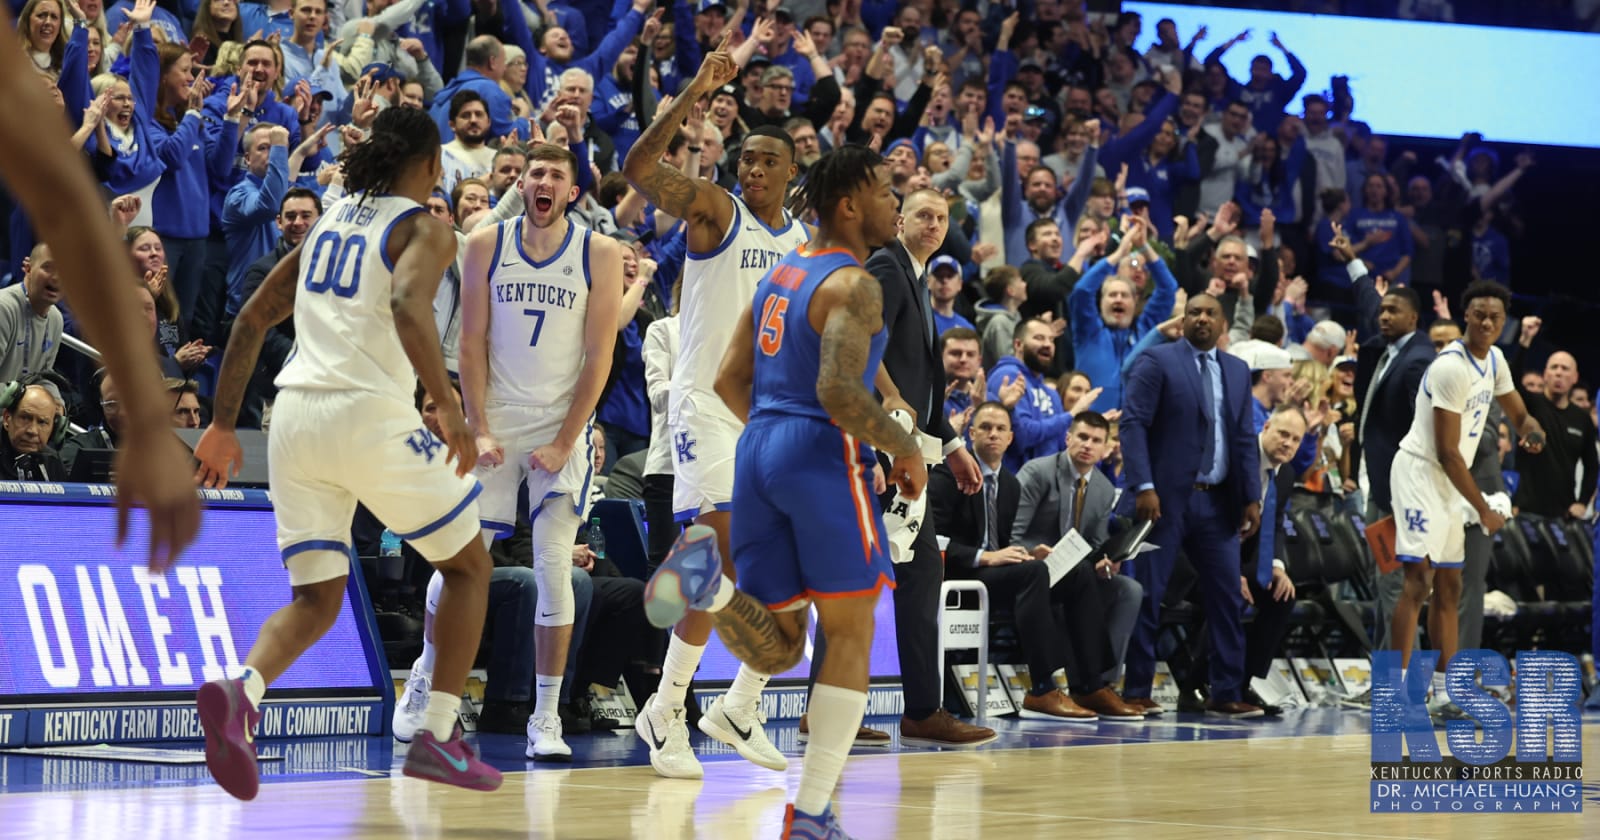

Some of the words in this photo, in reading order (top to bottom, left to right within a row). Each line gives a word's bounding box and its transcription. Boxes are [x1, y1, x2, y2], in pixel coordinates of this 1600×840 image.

[335, 203, 379, 227] OWEH
[304, 230, 367, 299] 00
[740, 248, 784, 269] KENT
[496, 282, 577, 310] KENTUCKY
[523, 308, 546, 347] 7
[758, 293, 790, 357] 15
[1468, 409, 1482, 438] 2
[1404, 508, 1429, 534] UK
[949, 623, 980, 634] GATORADE
[44, 709, 118, 743] KENTUCKY
[121, 708, 158, 740] FARM
[162, 707, 205, 738] BUREA
[263, 706, 282, 736] ON
[286, 705, 371, 735] COMMITMENT
